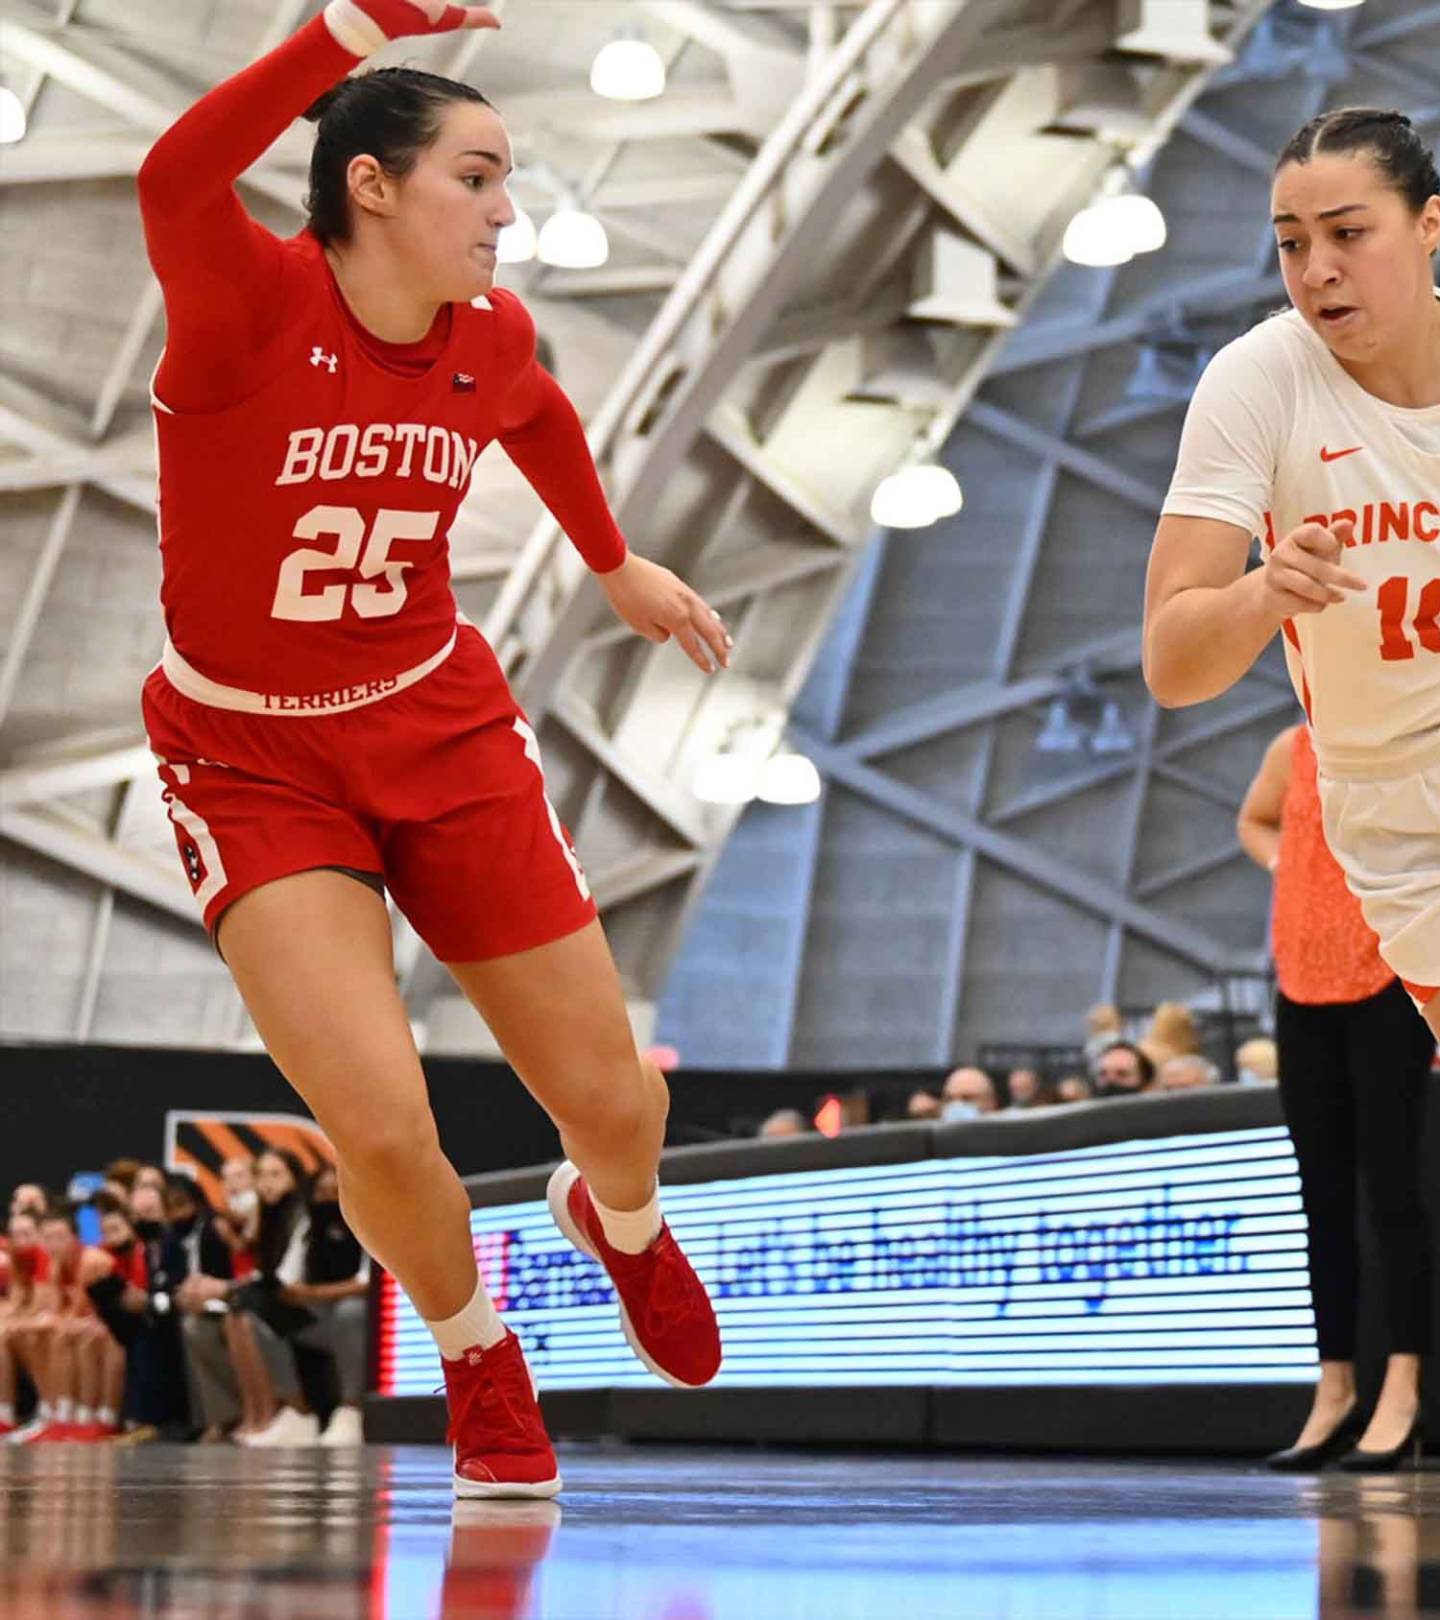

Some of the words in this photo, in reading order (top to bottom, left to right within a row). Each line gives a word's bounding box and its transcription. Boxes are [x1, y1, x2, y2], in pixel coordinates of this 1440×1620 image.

[275, 423, 478, 491] BOSTON
[270, 505, 440, 622] 25
[258, 675, 398, 710] TERRIERS
[811, 1208, 856, 1295] be
[871, 1199, 1013, 1319] healthy
